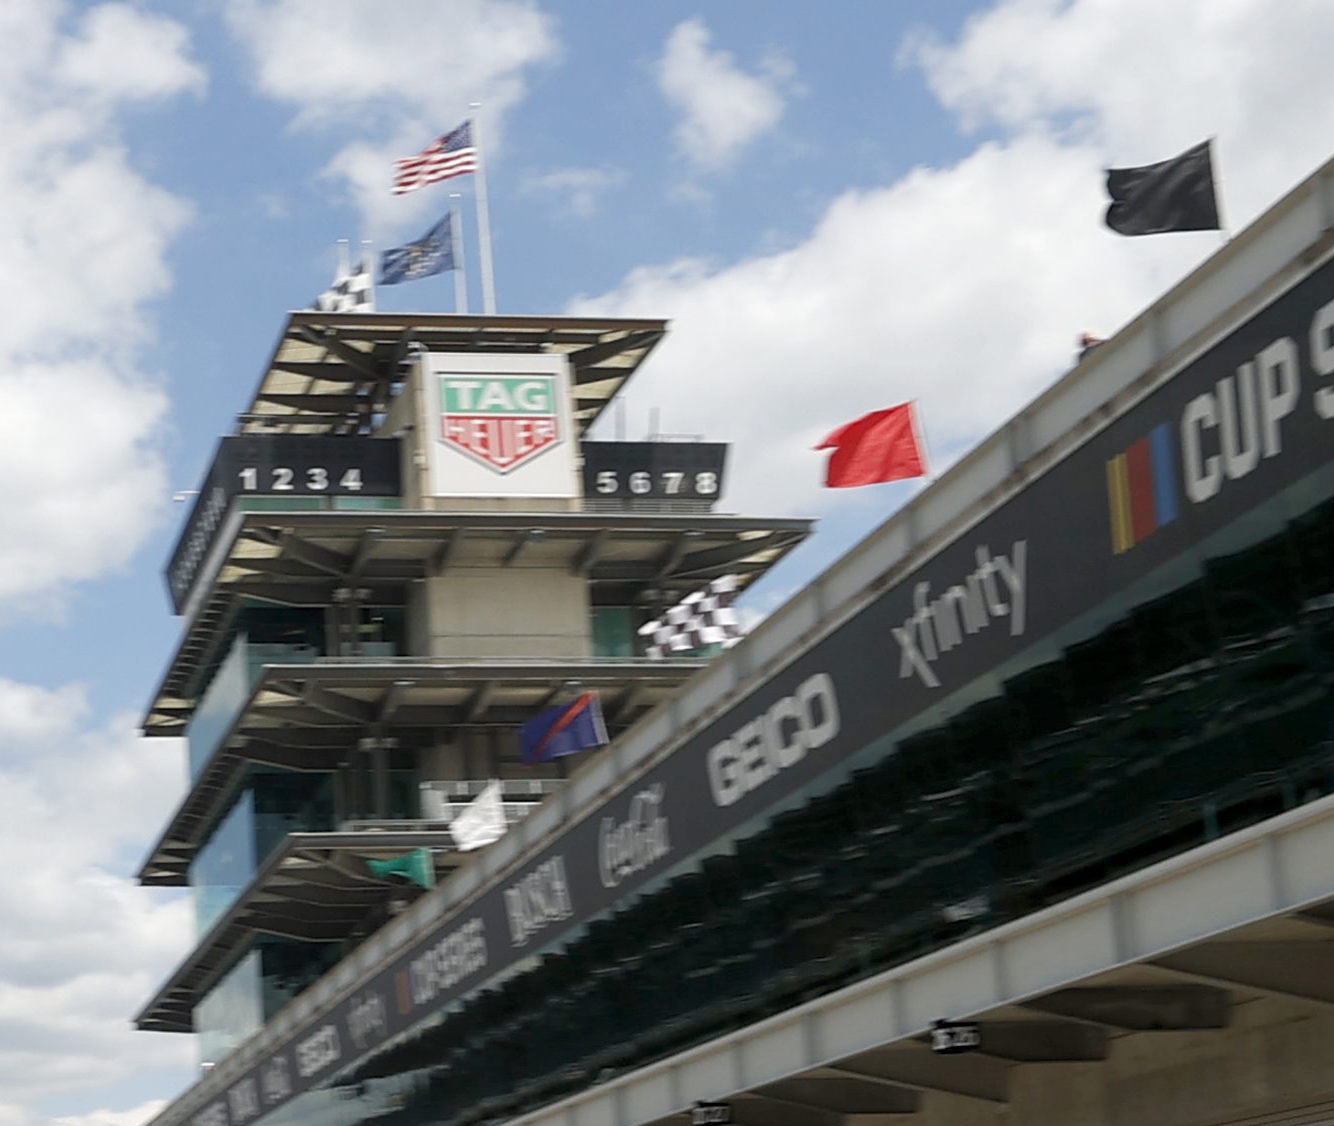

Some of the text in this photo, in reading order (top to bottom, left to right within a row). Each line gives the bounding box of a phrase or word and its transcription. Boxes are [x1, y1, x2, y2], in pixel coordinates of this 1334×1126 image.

[446, 381, 549, 411] TAG
[443, 419, 556, 464] HEUER
[1178, 336, 1301, 505] CUP
[238, 467, 364, 491] 1 2 3 4
[595, 471, 718, 495] 5 6 7 8
[890, 539, 1028, 689] xfinity
[706, 671, 842, 808] GEICO
